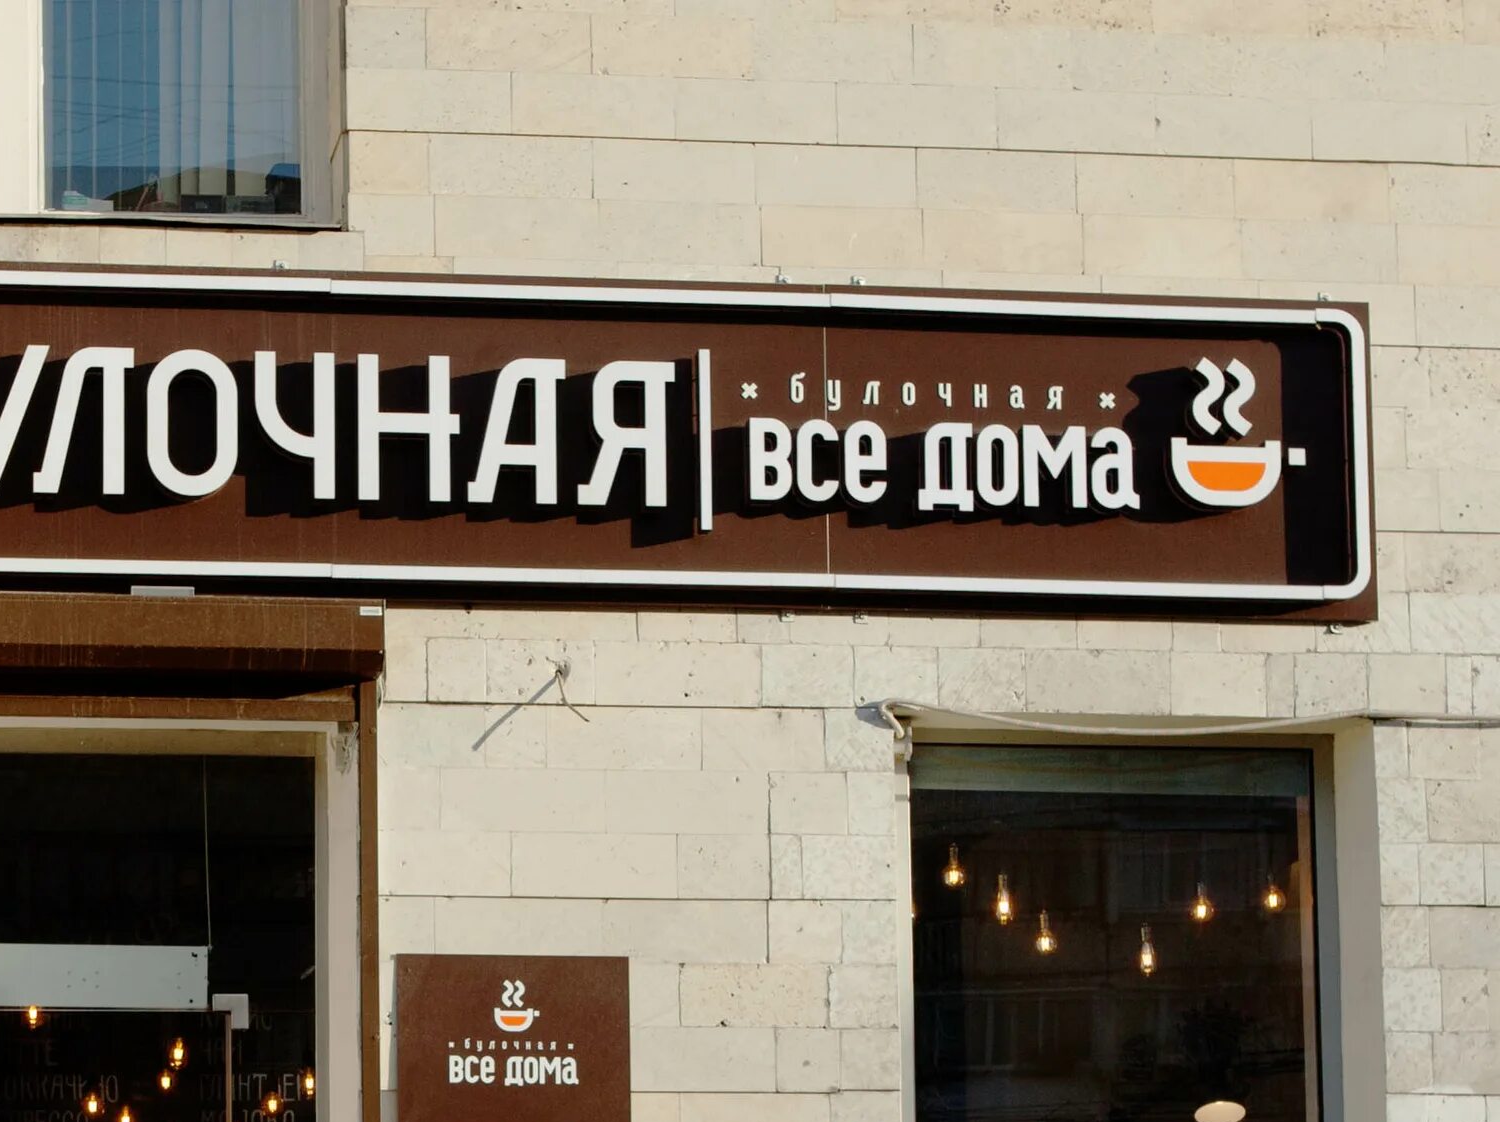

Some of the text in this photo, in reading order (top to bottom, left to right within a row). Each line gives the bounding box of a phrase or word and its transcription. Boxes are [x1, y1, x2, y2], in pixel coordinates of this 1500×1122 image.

[790, 371, 1063, 412] булочная
[748, 416, 1140, 512] все дома
[464, 1037, 557, 1052] булочная
[448, 1055, 579, 1087] все дома
